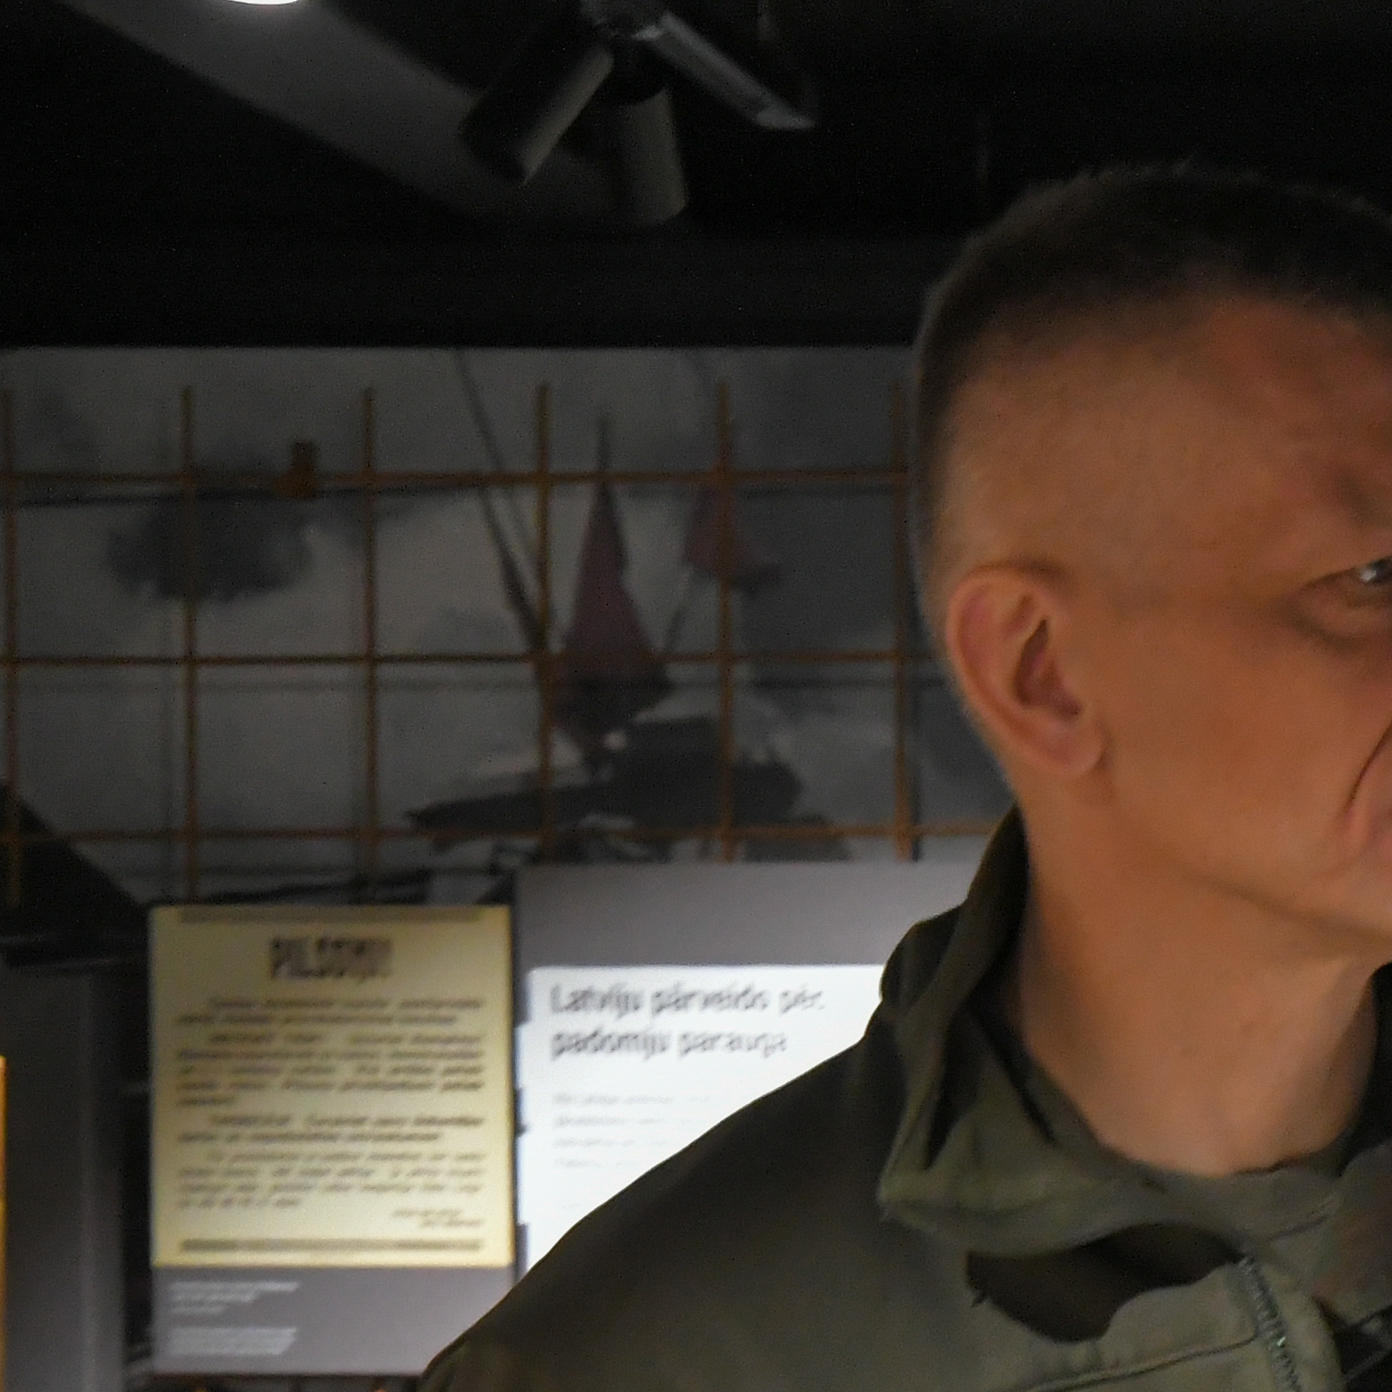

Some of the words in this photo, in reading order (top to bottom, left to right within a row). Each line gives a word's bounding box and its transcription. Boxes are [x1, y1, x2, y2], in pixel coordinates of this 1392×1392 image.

[550, 982, 642, 1021] Latviju
[550, 1028, 672, 1062] padomju
[677, 1031, 788, 1060] parauga
